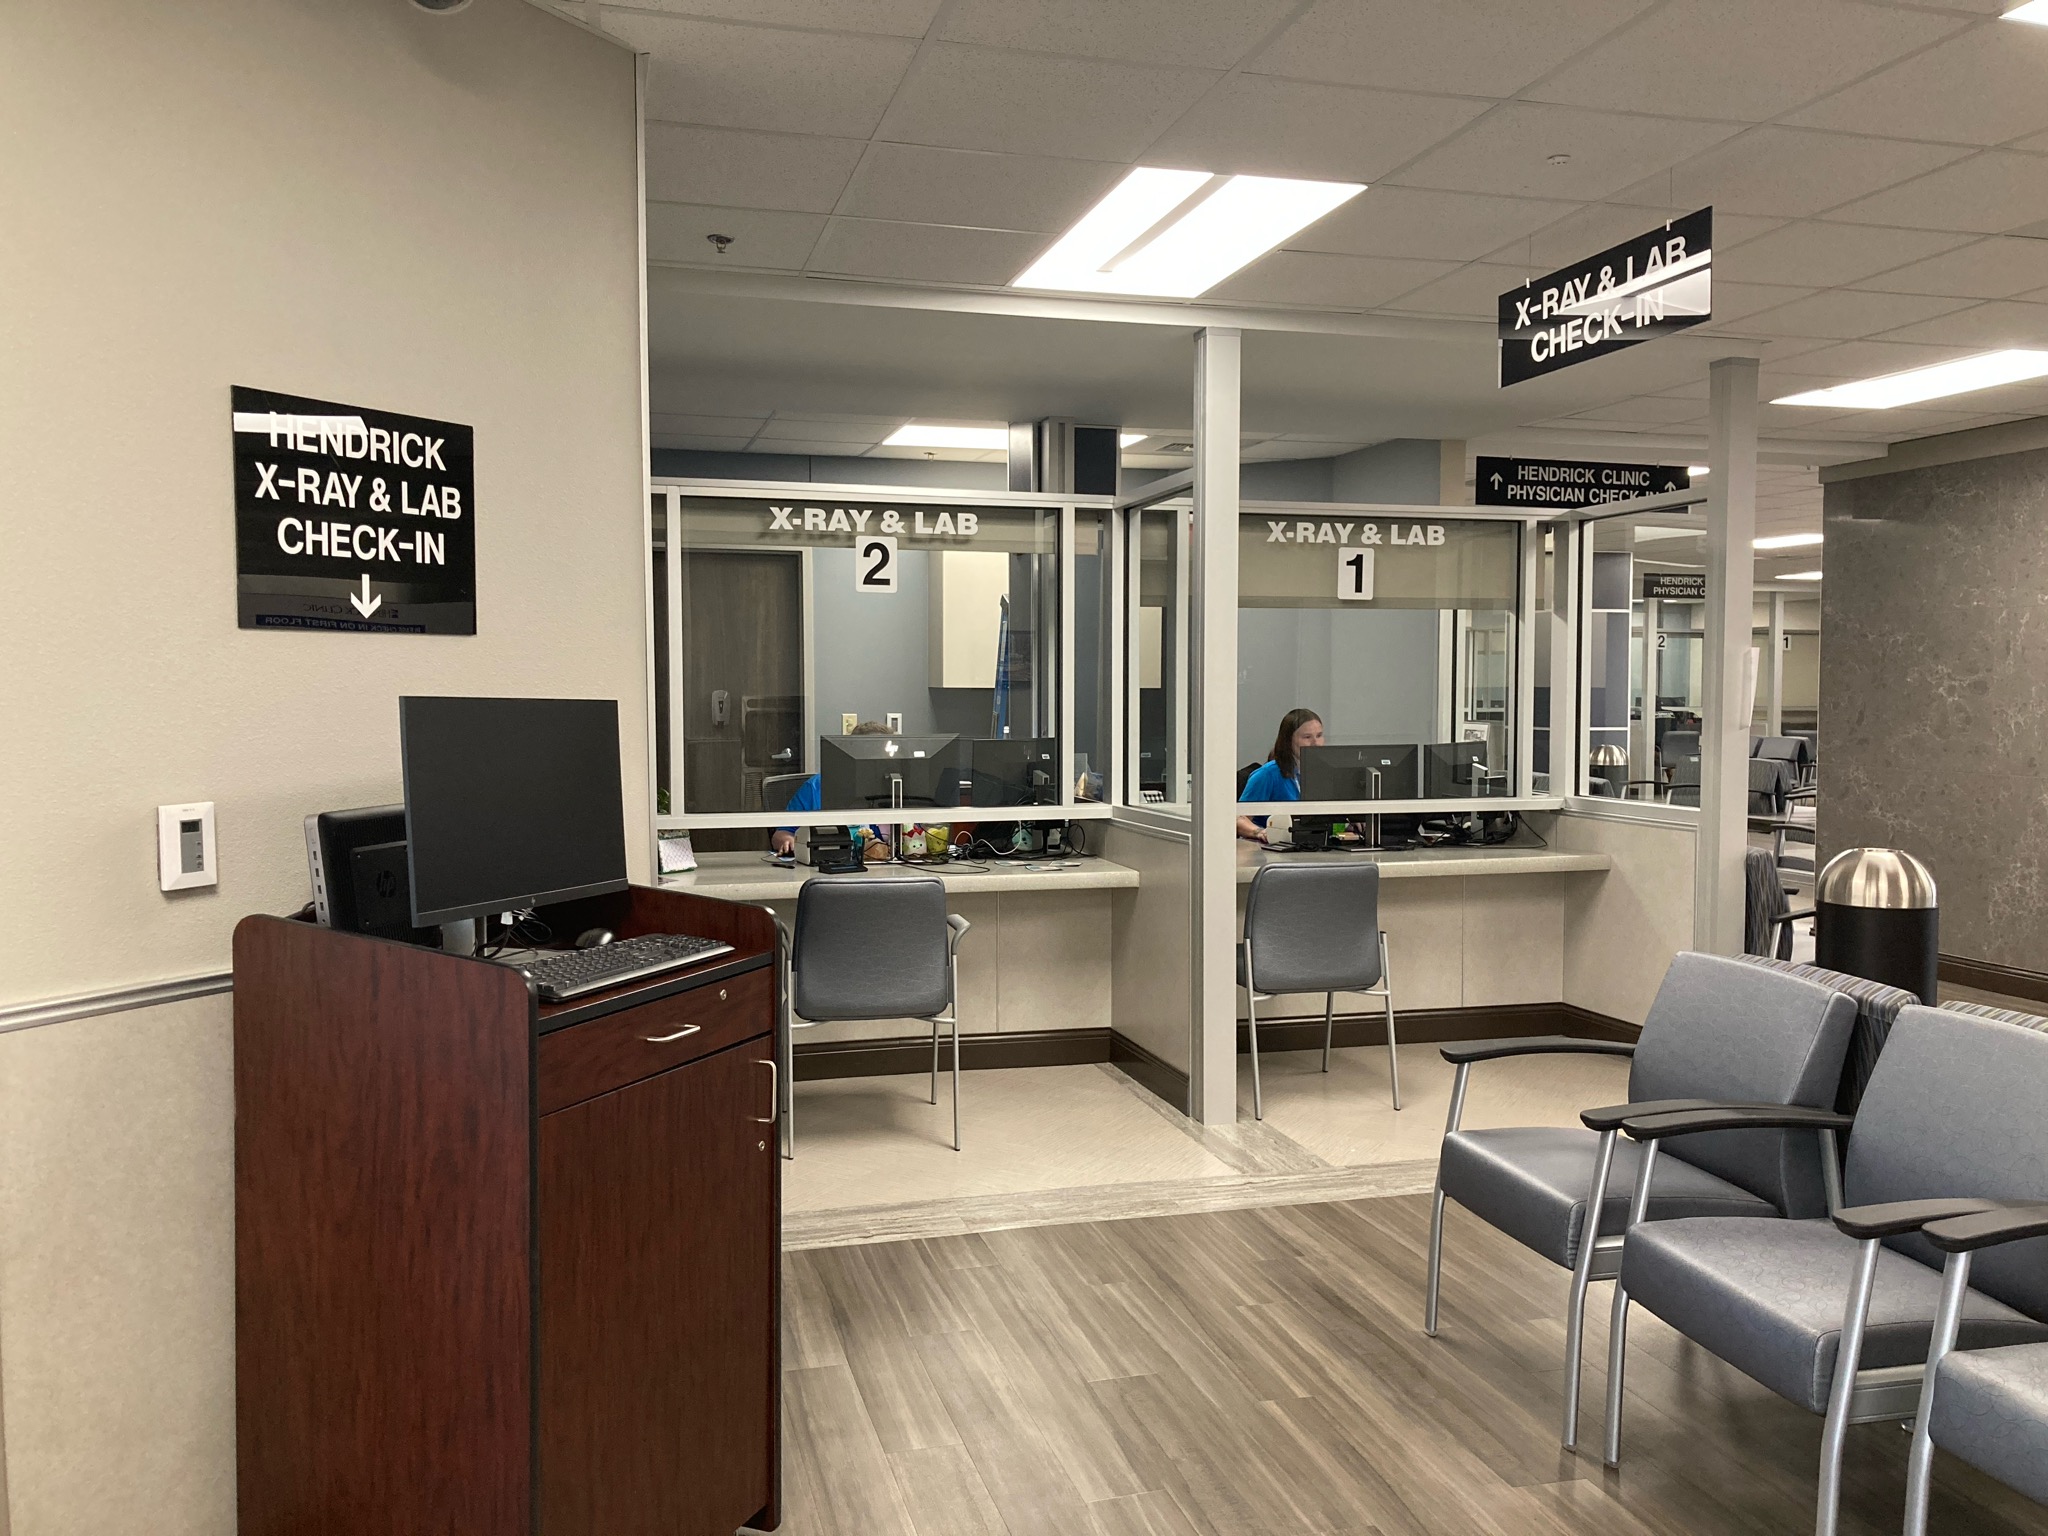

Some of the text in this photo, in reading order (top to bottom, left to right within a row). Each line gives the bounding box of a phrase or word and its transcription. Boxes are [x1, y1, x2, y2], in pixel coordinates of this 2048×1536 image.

[1514, 235, 1688, 330] X-RAY & LAB
[1530, 288, 1664, 363] CHECK-IN
[269, 411, 447, 472] HENDRICK
[1517, 464, 1650, 487] HENDRICK CLINIC
[254, 461, 462, 520] X-RAY & LAB
[1507, 484, 1585, 503] PHYSICIAN
[769, 506, 979, 535] X-RAY & LAB
[1266, 521, 1446, 546] X-RAY & LAB
[277, 517, 445, 565] CHECK-IN
[862, 541, 891, 586] 2
[1346, 553, 1364, 594] 1
[1653, 586, 1698, 596] PHYSICIAN
[1660, 577, 1704, 586] HENDRICK
[1657, 635, 1666, 648] 2
[1783, 636, 1789, 649] 1
